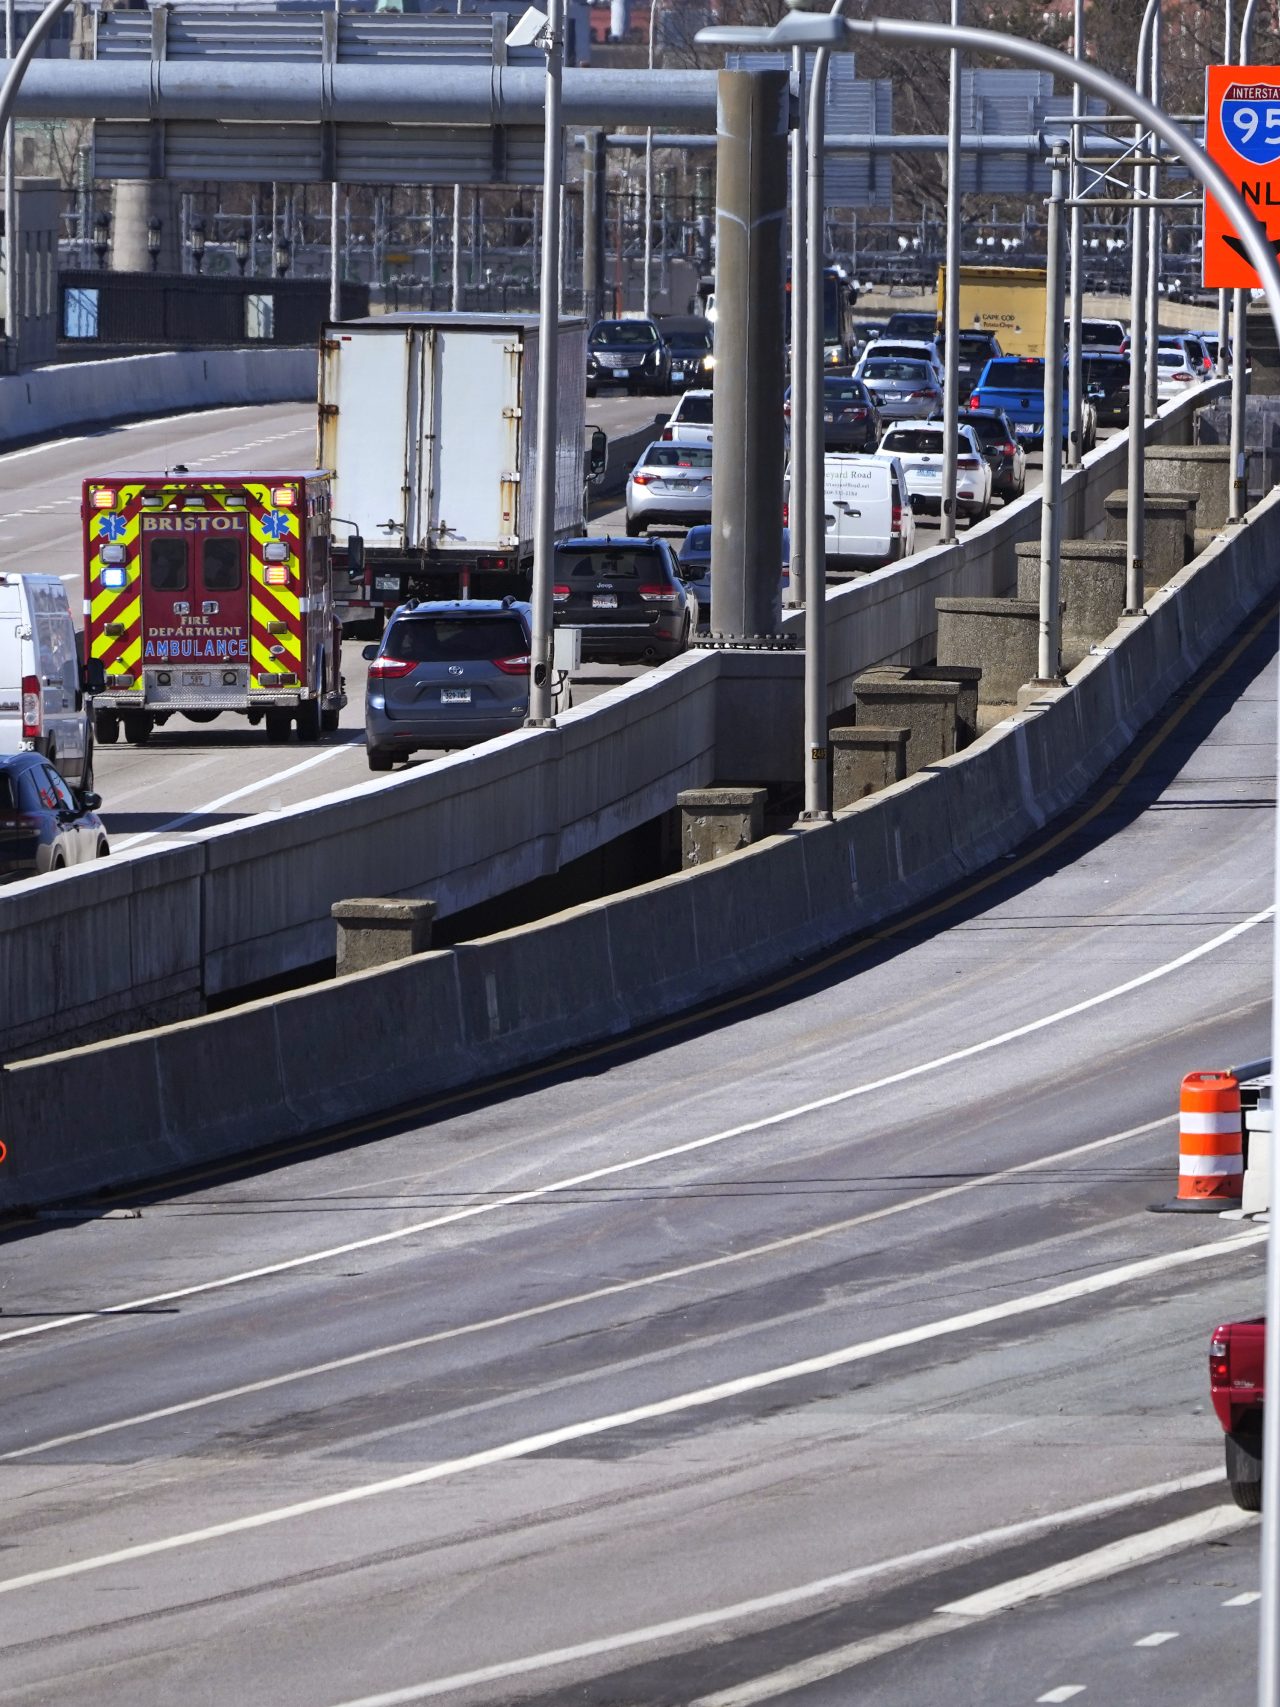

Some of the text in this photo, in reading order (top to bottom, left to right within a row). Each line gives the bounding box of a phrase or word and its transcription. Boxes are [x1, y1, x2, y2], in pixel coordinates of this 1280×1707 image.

[826, 471, 872, 480] eyard Road
[126, 493, 133, 505] 2
[255, 492, 264, 505] 2
[143, 517, 244, 531] BRISTOL
[181, 616, 209, 625] FIRE
[149, 626, 241, 637] DEPARTMENT
[145, 639, 248, 656] AMBULANCE
